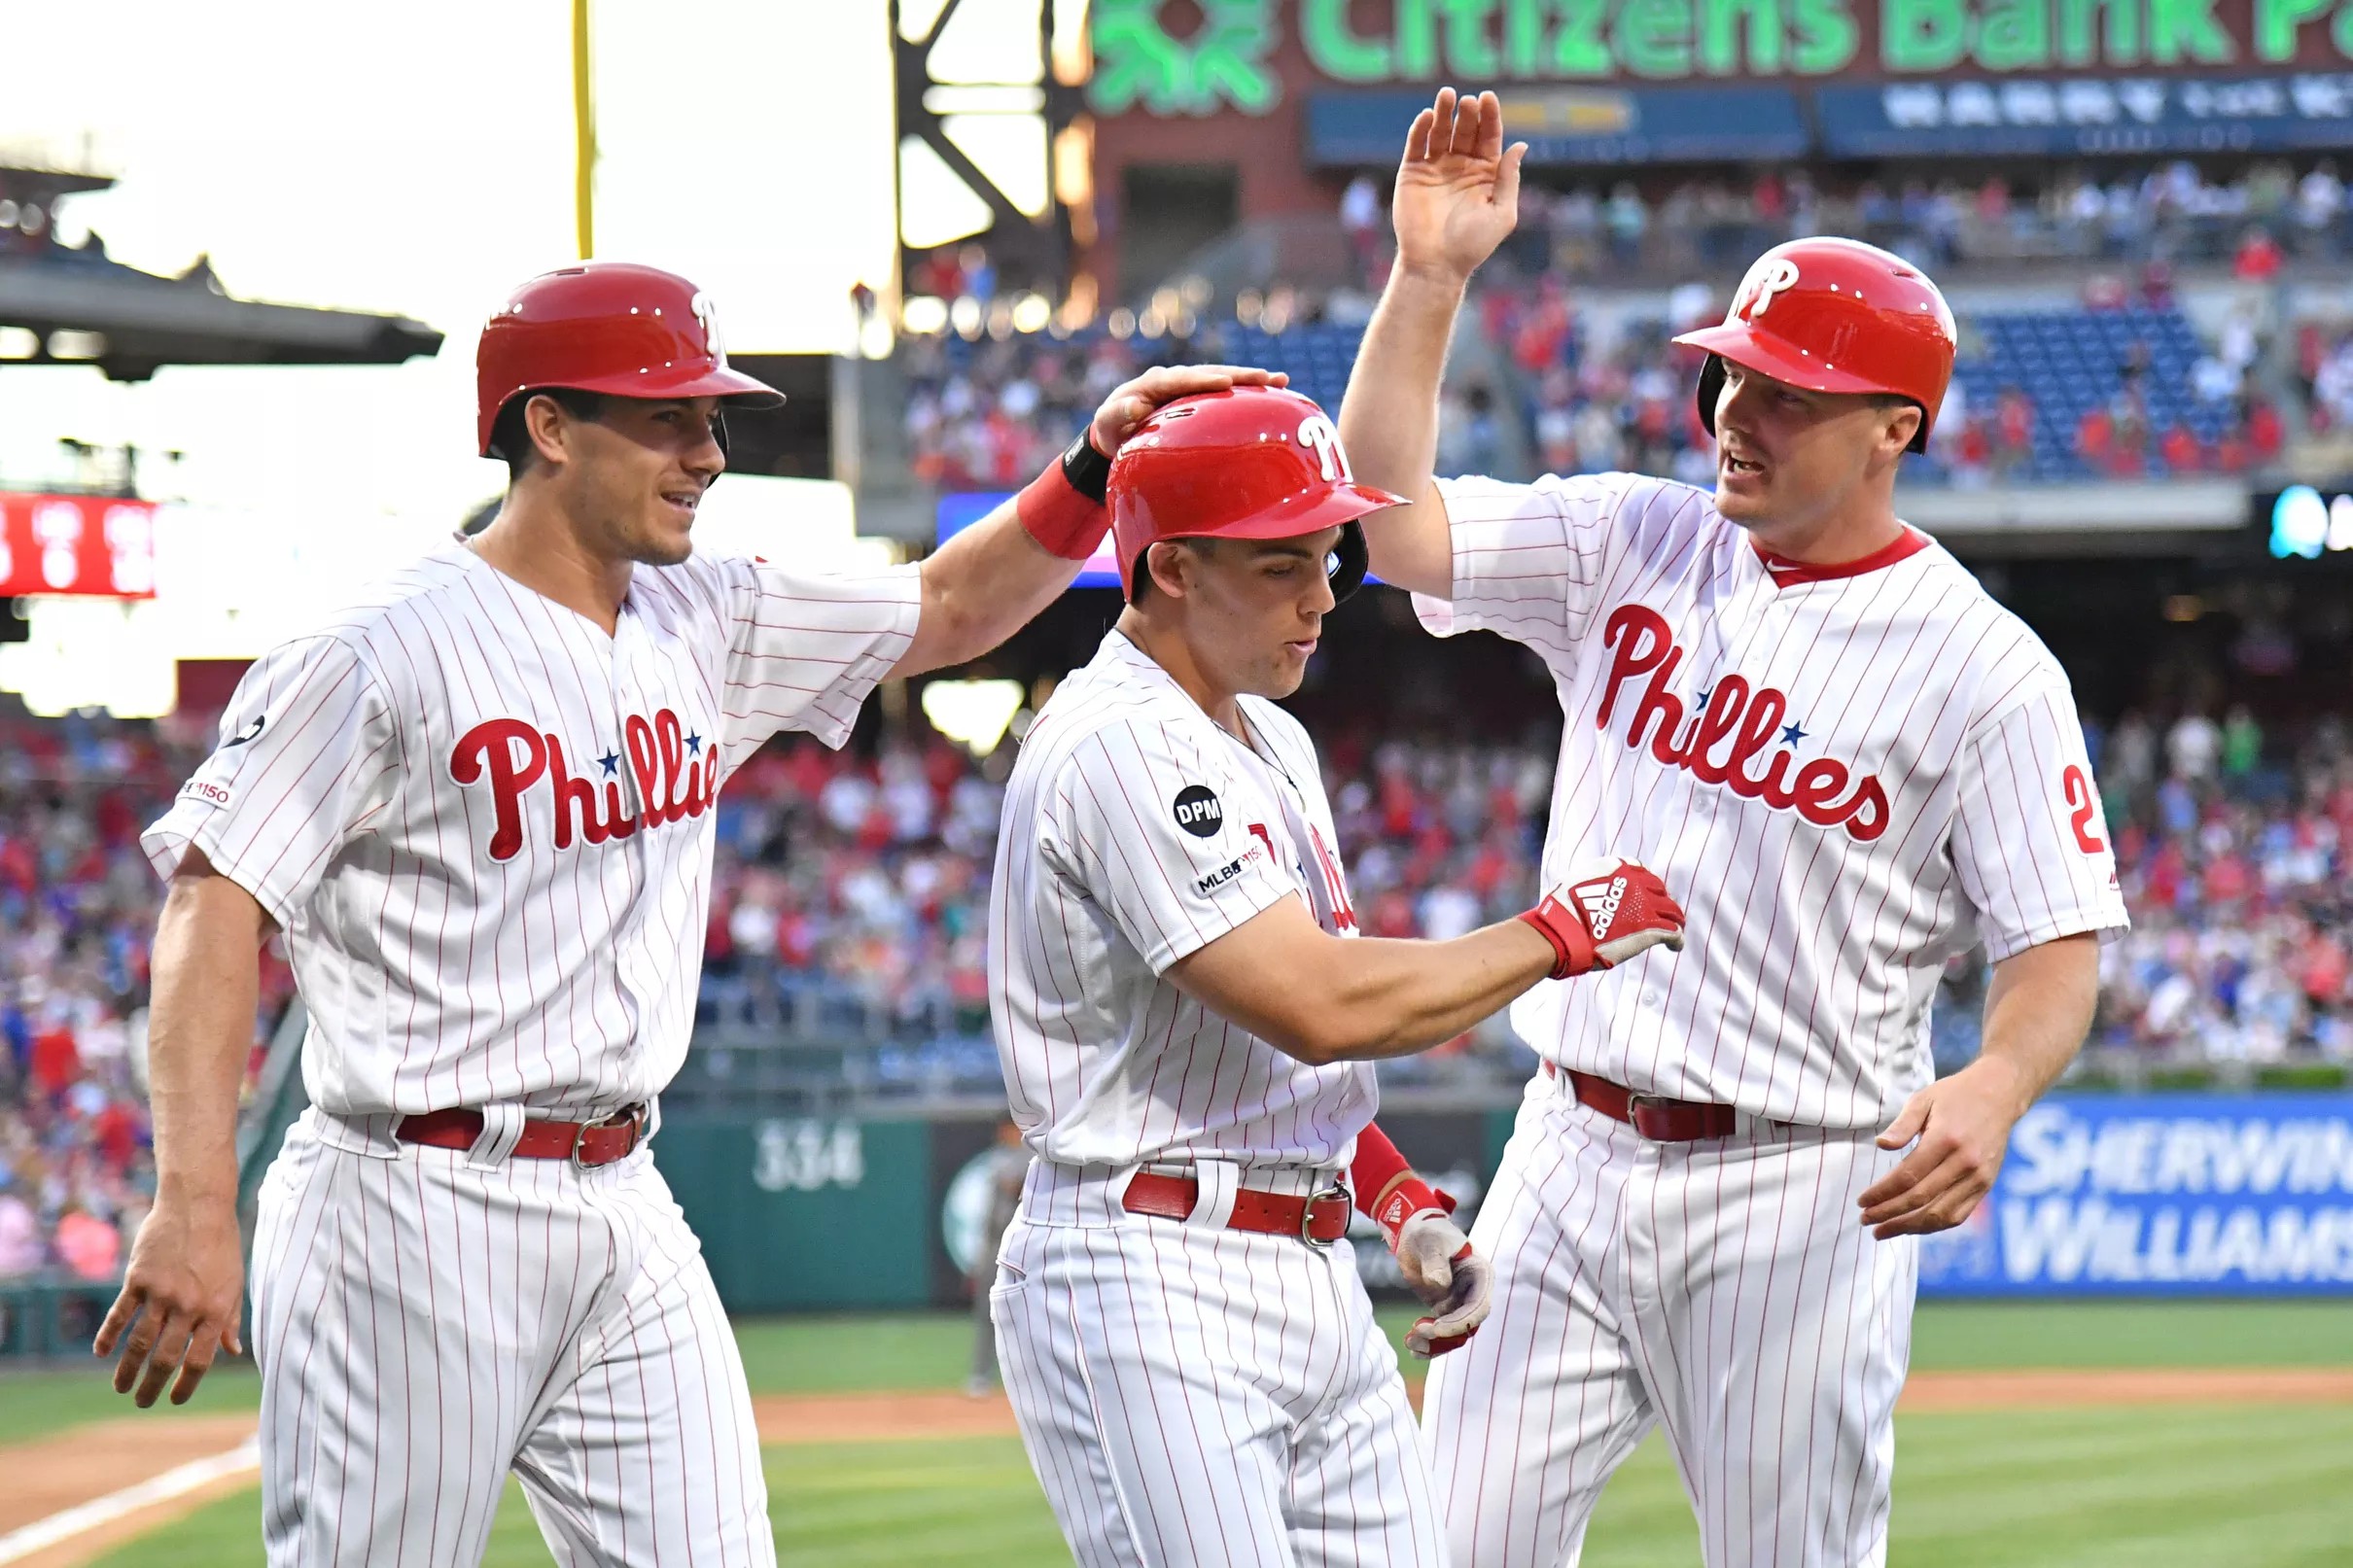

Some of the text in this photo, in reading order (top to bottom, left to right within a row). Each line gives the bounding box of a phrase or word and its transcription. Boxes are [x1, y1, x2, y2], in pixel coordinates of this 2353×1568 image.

[1596, 603, 1891, 843] Phillies
[448, 708, 719, 862] Phillie
[1176, 797, 1221, 824] DPM
[1197, 864, 1235, 893] MLB
[1592, 876, 1629, 941] adidas
